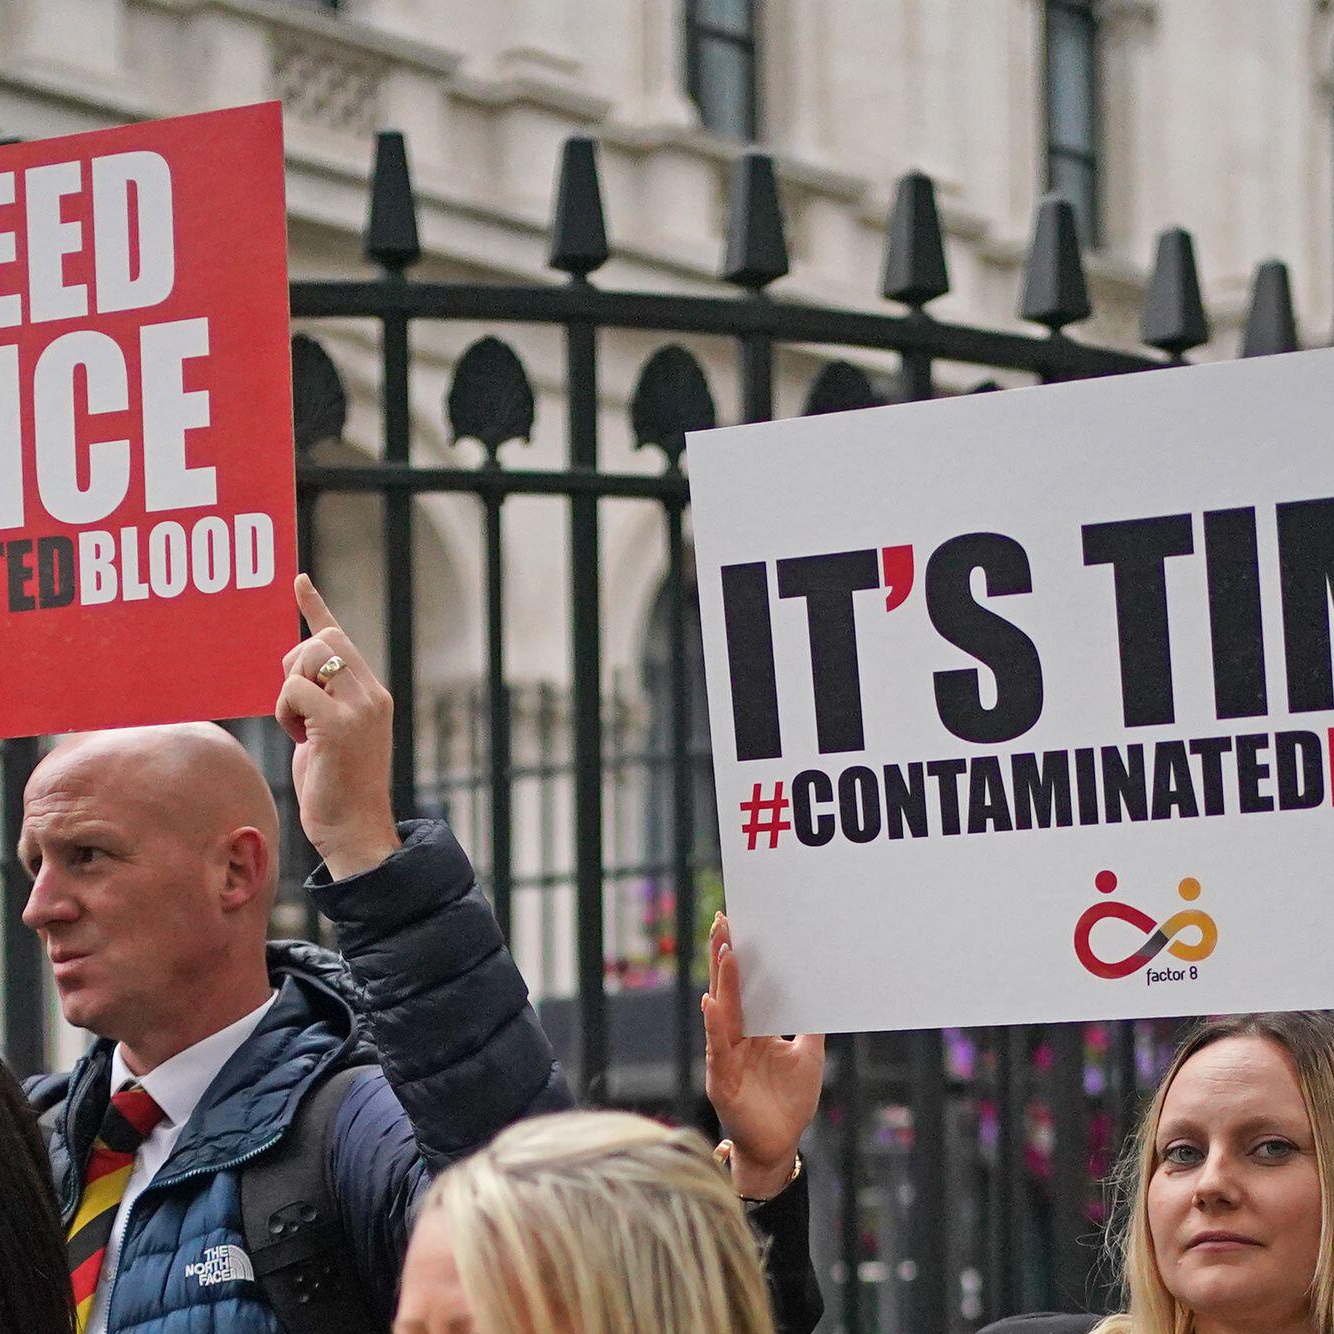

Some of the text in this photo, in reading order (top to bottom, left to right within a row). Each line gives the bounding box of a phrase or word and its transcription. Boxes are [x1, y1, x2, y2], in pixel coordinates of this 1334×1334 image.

[1146, 965, 1198, 986] factor 8
[204, 1244, 228, 1260] THE
[185, 1256, 229, 1277] NORTH
[199, 1268, 231, 1286] FACE
